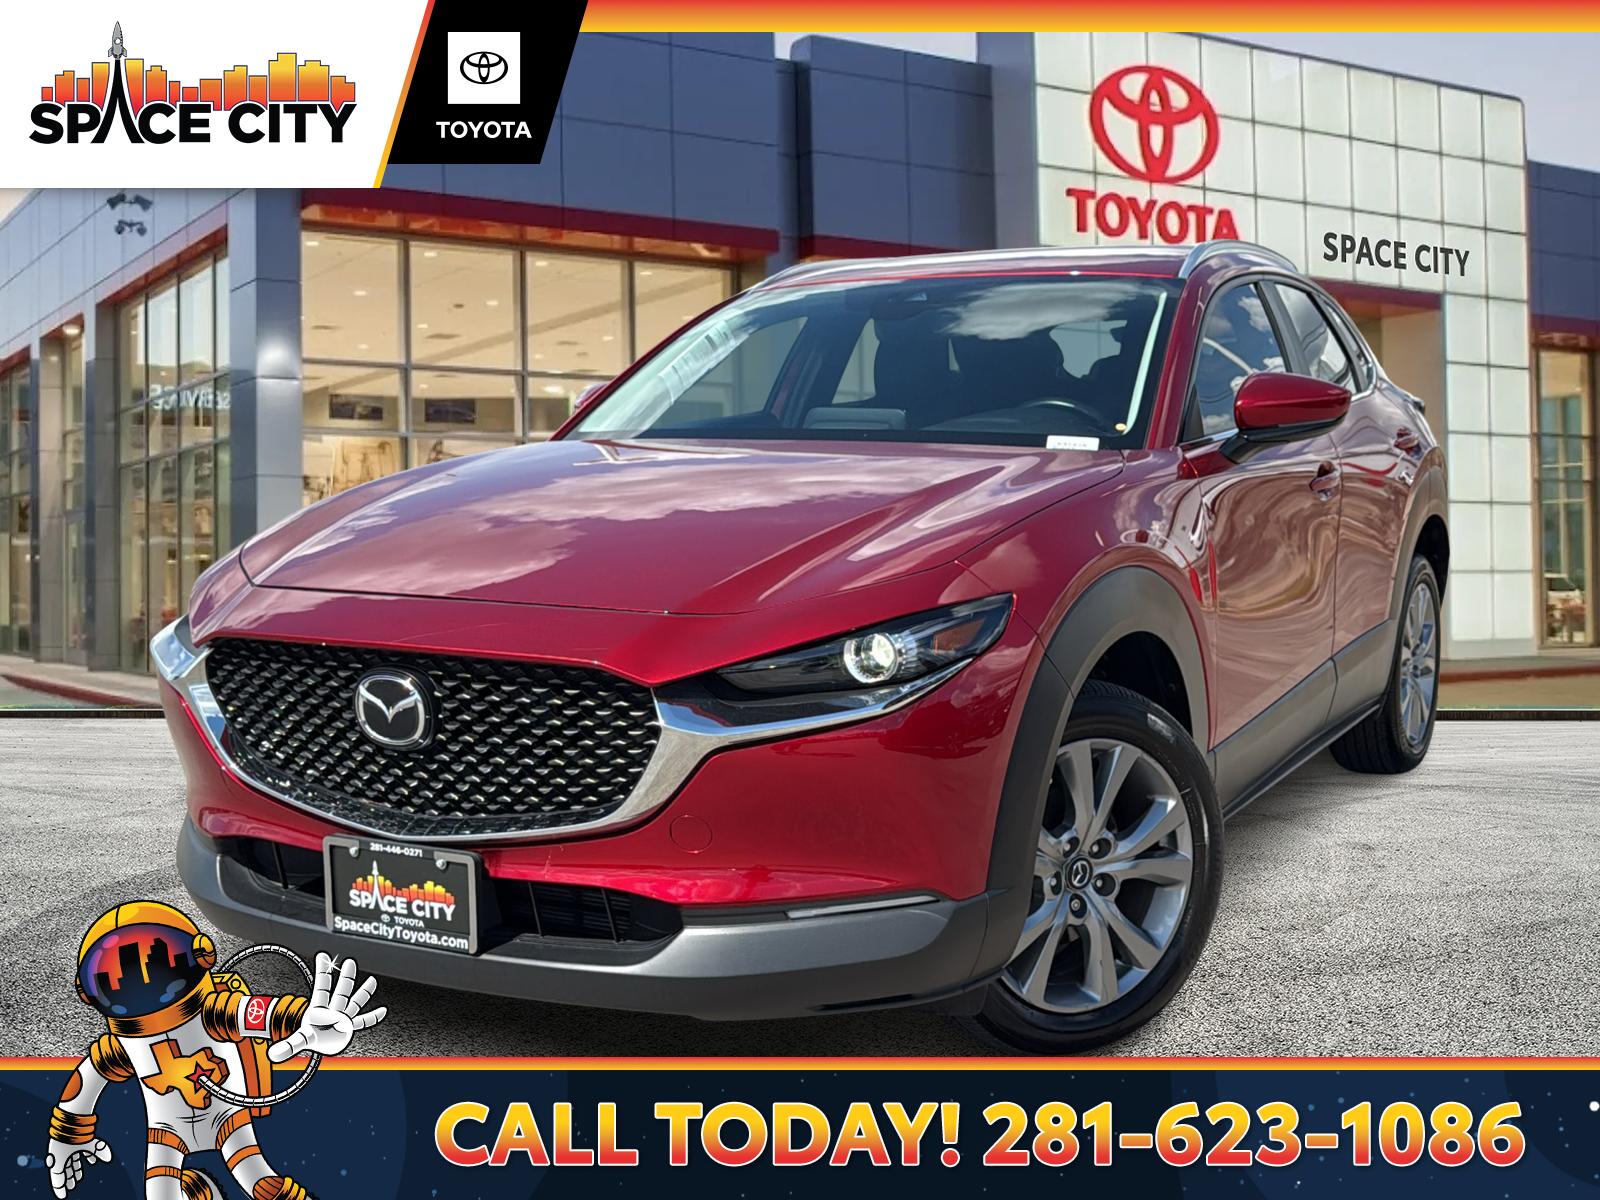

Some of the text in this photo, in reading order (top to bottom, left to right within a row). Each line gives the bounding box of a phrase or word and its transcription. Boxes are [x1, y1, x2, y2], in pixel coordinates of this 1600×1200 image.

[1066, 187, 1240, 244] TOYOTA
[1323, 231, 1470, 277] SPACE CITY
[369, 842, 423, 858] 281-446-0271
[349, 875, 456, 922] SPACE CITY
[334, 915, 469, 950] SpaceCityToyota.com
[394, 915, 425, 929] TOYOTA
